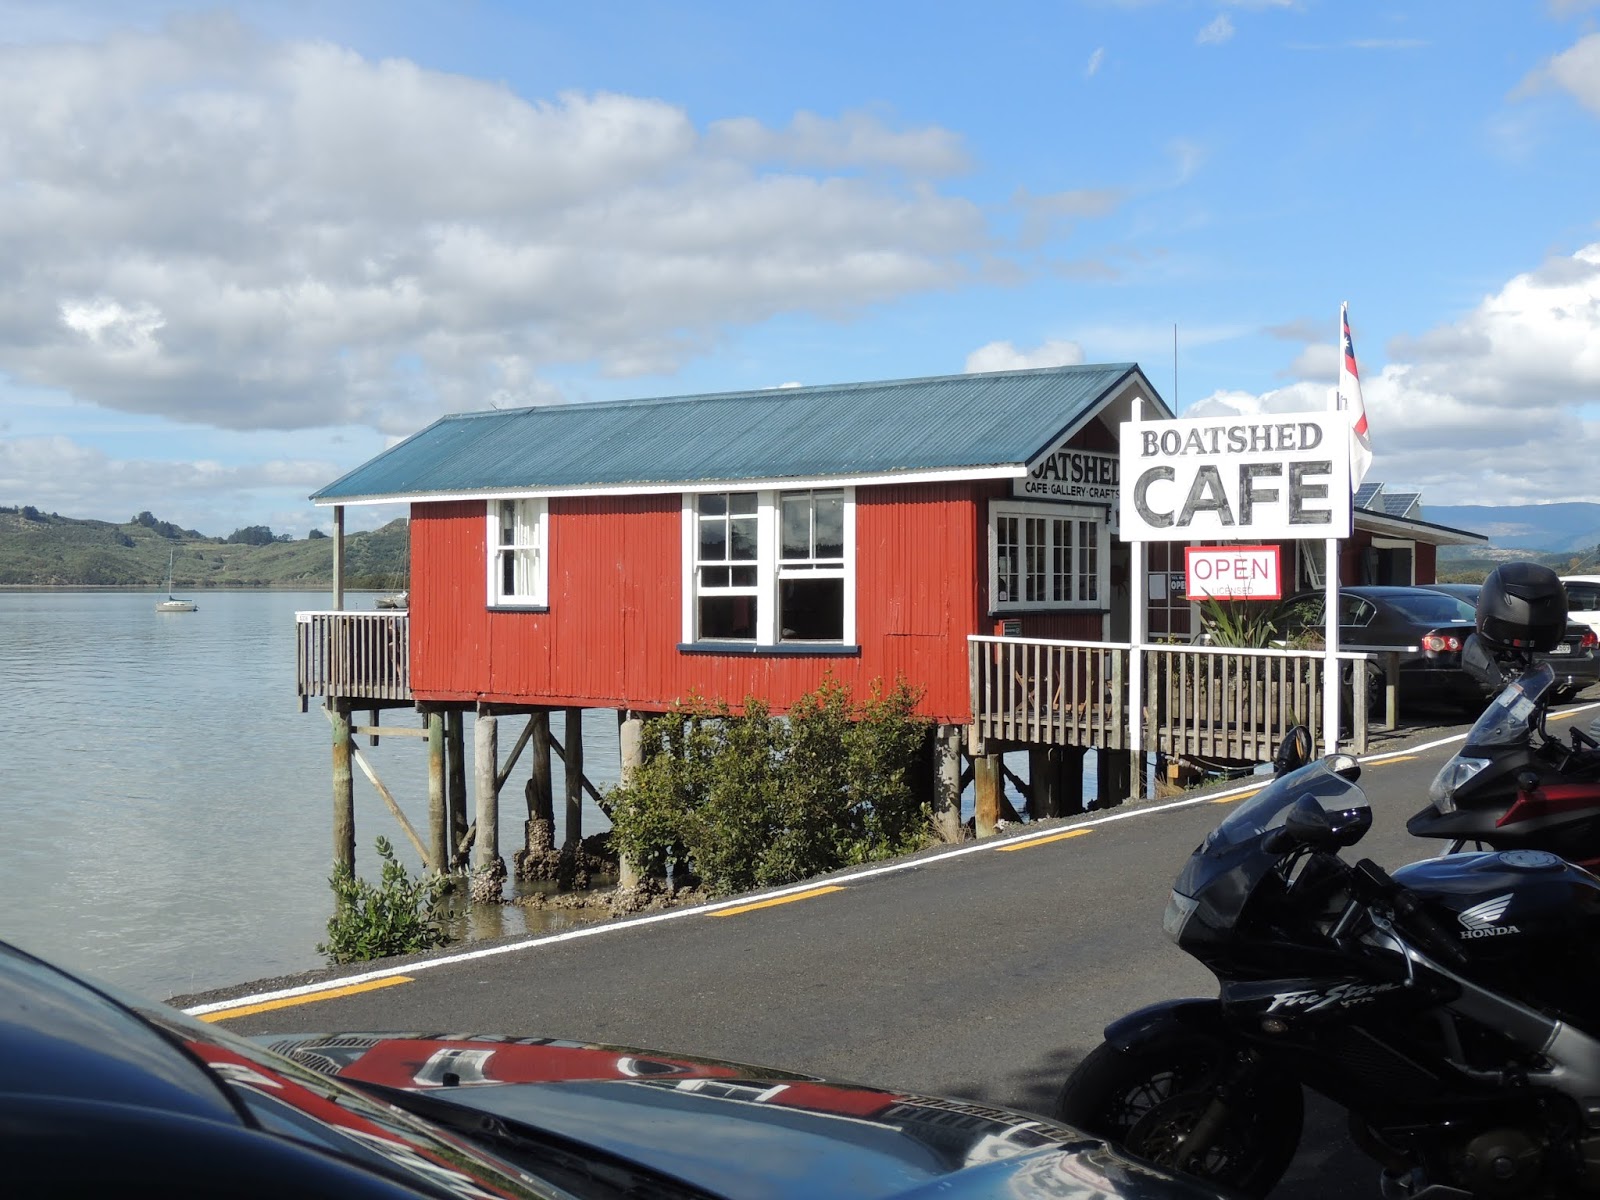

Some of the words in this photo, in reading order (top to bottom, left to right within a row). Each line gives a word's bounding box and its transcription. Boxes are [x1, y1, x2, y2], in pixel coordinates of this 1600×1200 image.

[1141, 422, 1323, 457] BOATSHED
[1025, 481, 1048, 494] CAFE
[1051, 484, 1087, 497] GALLERY
[1133, 460, 1333, 529] CAFE
[1194, 558, 1268, 580] OPEN
[1171, 580, 1186, 590] OPE
[1211, 587, 1254, 595] LICENSED
[1460, 925, 1521, 939] HONDA
